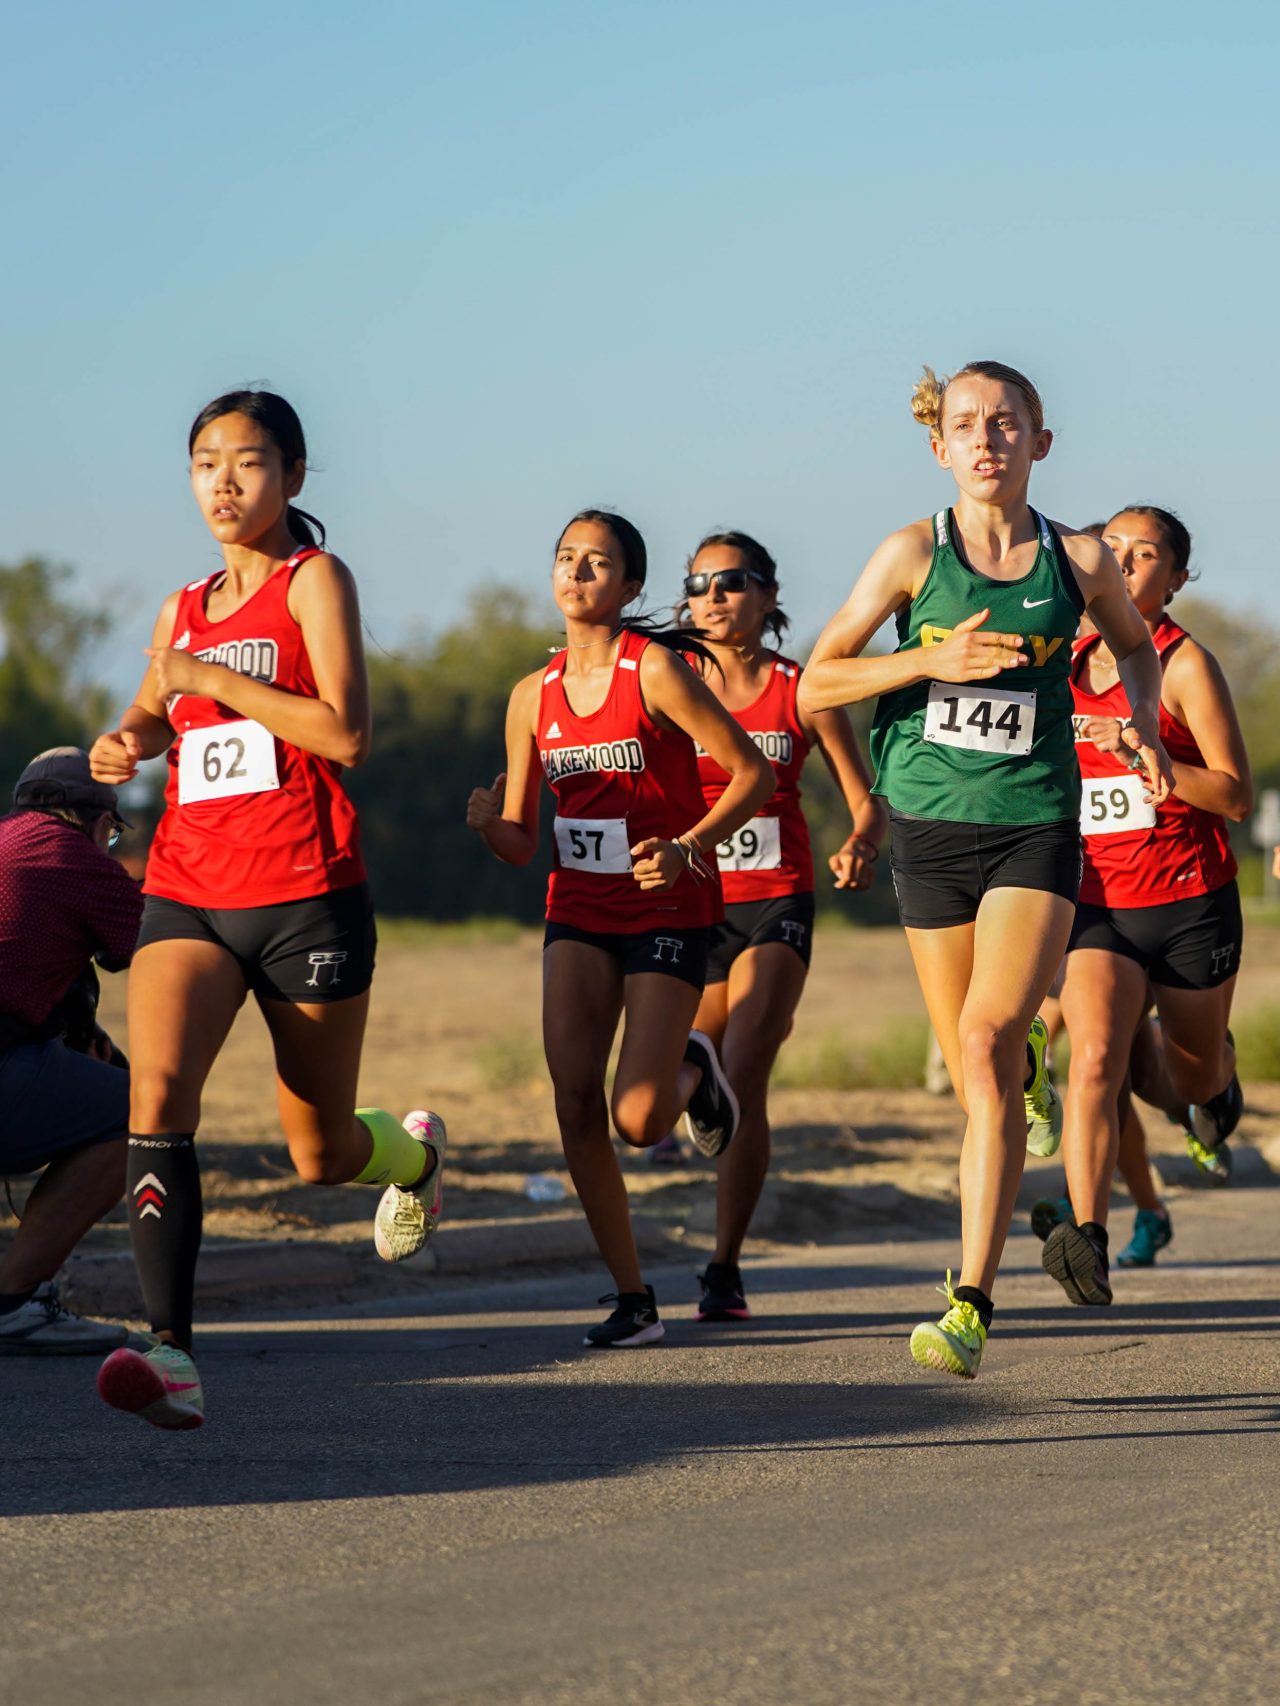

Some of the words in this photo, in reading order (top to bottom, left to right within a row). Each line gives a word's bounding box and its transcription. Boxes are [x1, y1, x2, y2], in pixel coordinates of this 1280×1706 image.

[921, 624, 1065, 667] PY
[939, 696, 1022, 740] 144
[203, 737, 247, 782] 62
[541, 737, 645, 784] LAKEWOOD
[1090, 788, 1130, 821] 59
[569, 829, 604, 861] 57
